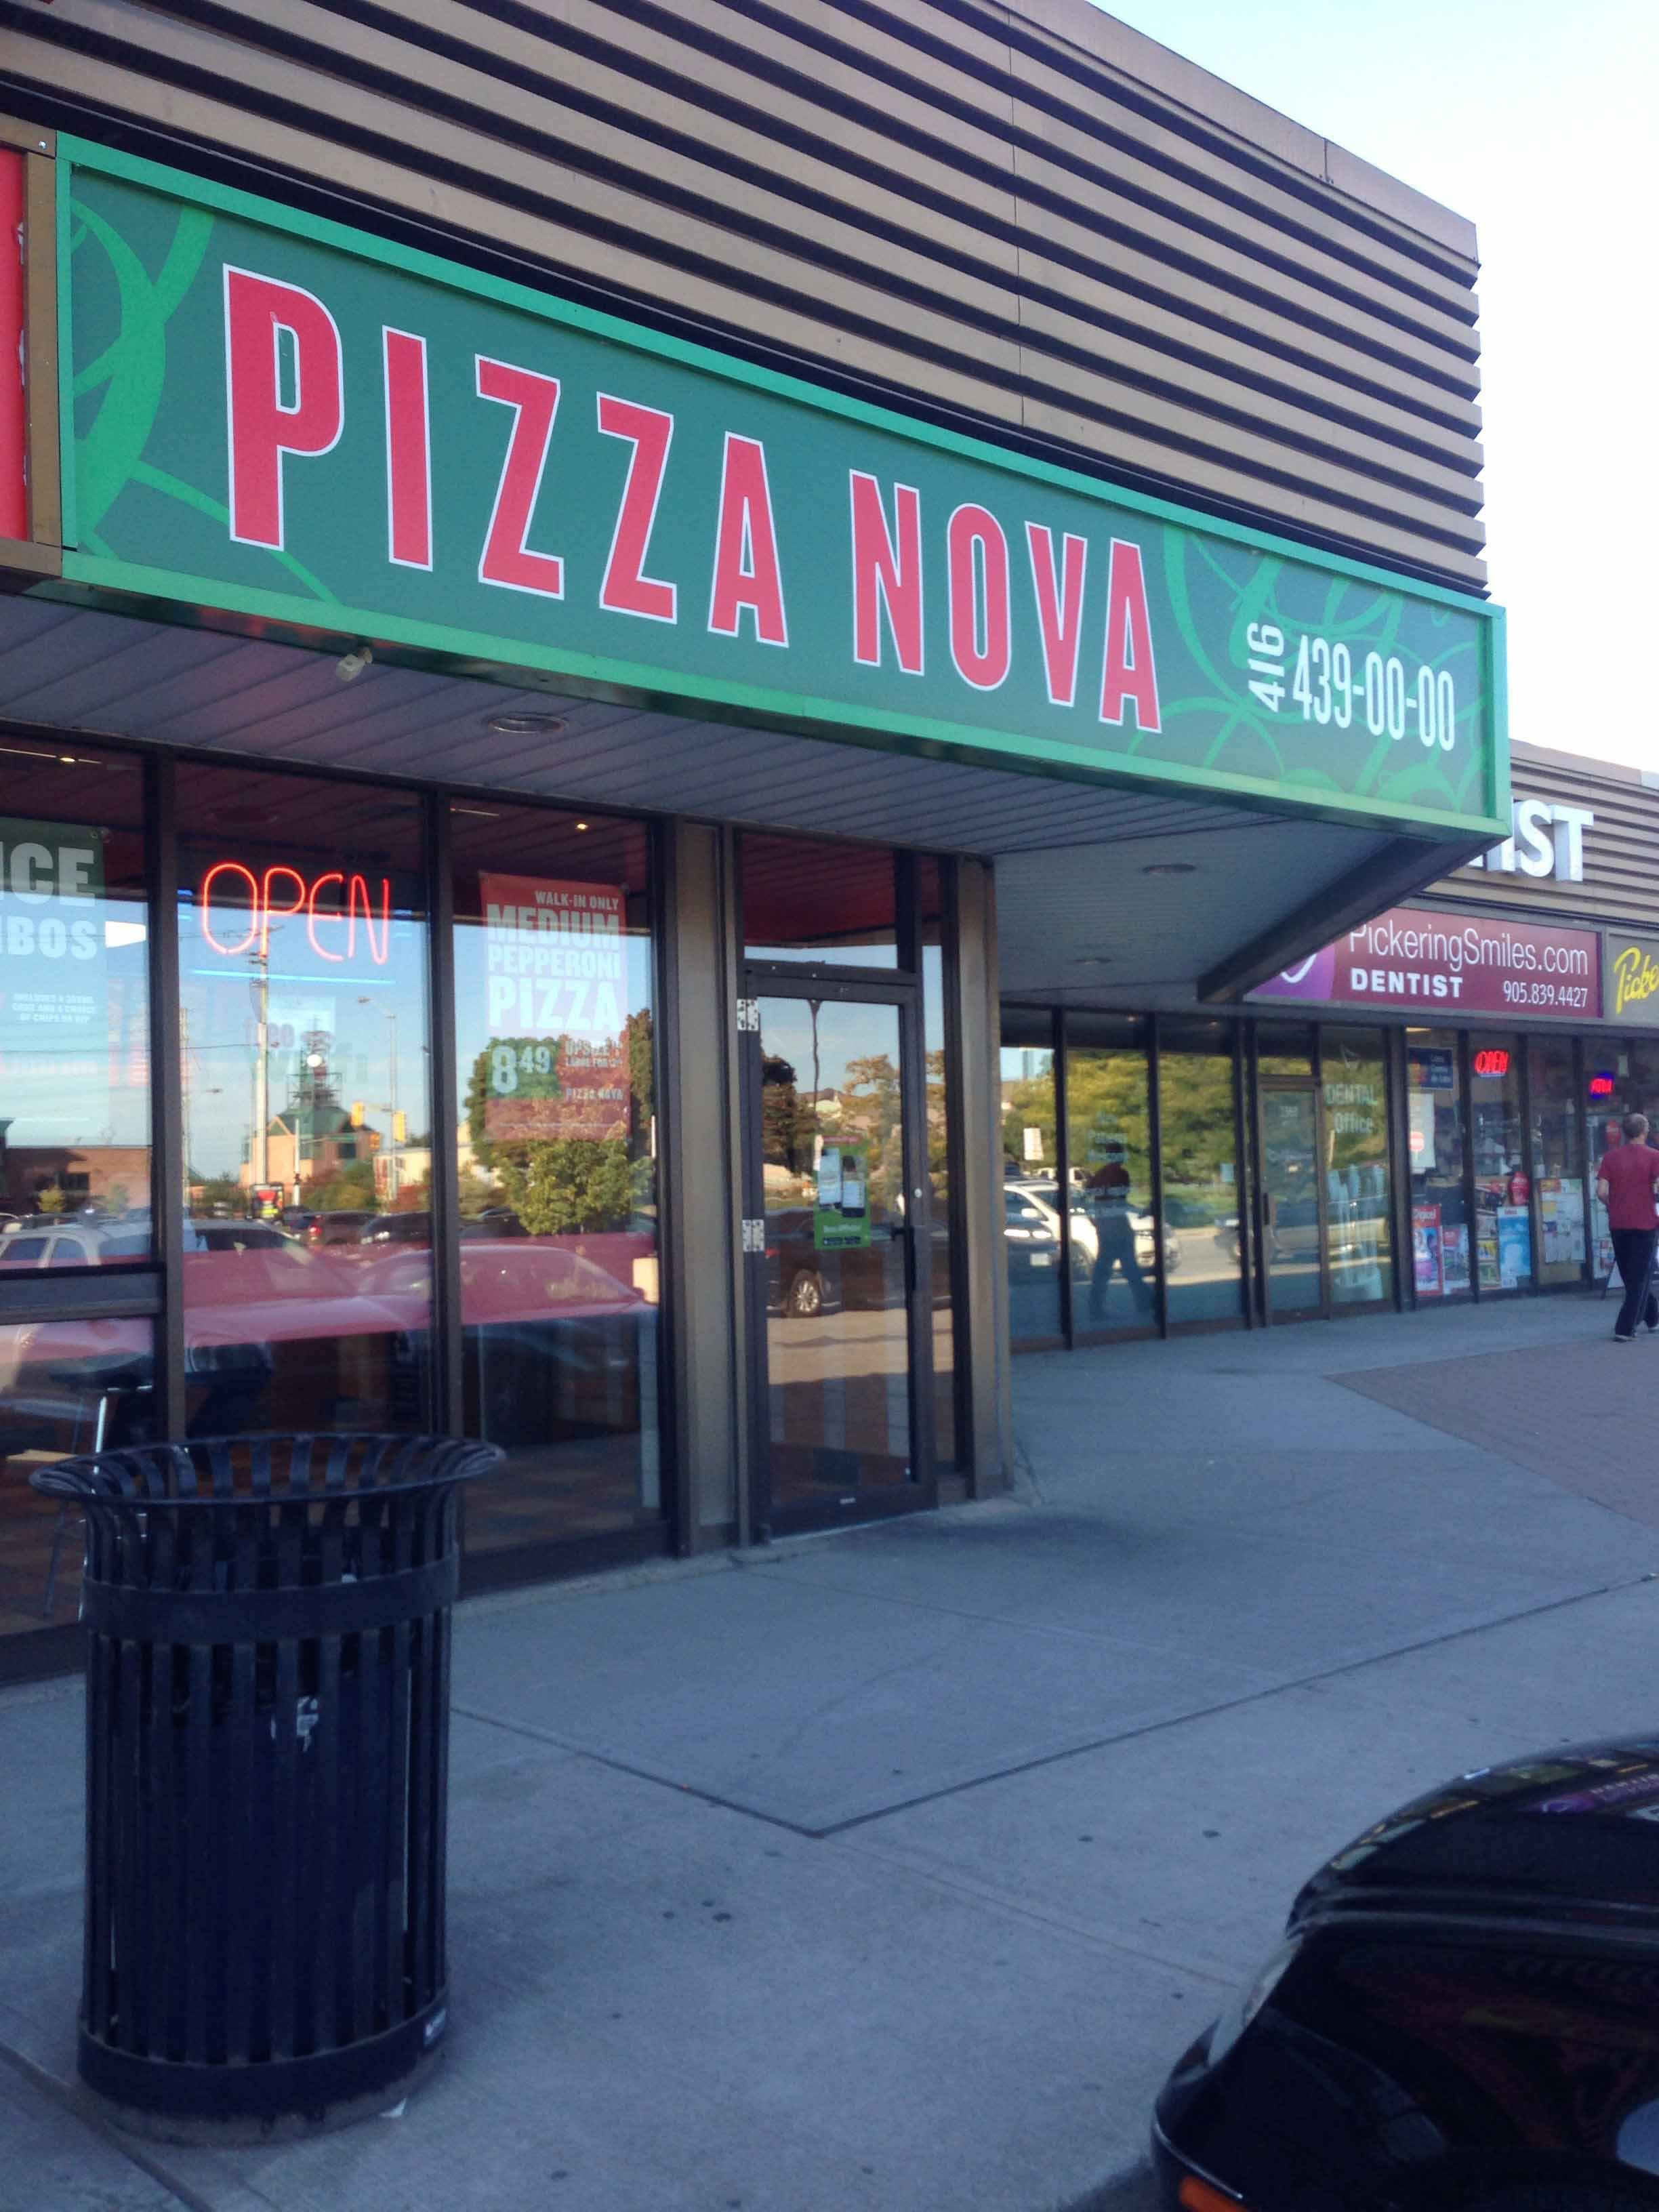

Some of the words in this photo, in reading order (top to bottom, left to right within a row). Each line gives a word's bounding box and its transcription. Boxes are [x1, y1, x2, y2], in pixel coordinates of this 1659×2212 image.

[222, 262, 790, 649] PIZZA
[849, 468, 1162, 734] NOVA
[1247, 621, 1286, 713] 416
[1292, 634, 1456, 751] 439-00-00
[1466, 798, 1594, 882] IST
[0, 840, 96, 907] CE
[535, 890, 586, 908] WALK-IN
[589, 895, 619, 911] ONLY
[0, 915, 98, 960] BOS
[202, 862, 390, 964] OPEN
[487, 903, 619, 950] MEDIUM
[487, 943, 621, 979] PEPPERONI
[1350, 919, 1589, 975] PickeringSmiles.com
[488, 975, 625, 1031] PIZZA
[1351, 967, 1463, 998] DENTIST
[1503, 980, 1589, 1008] 905.839.4427
[1334, 1111, 1374, 1134] Office
